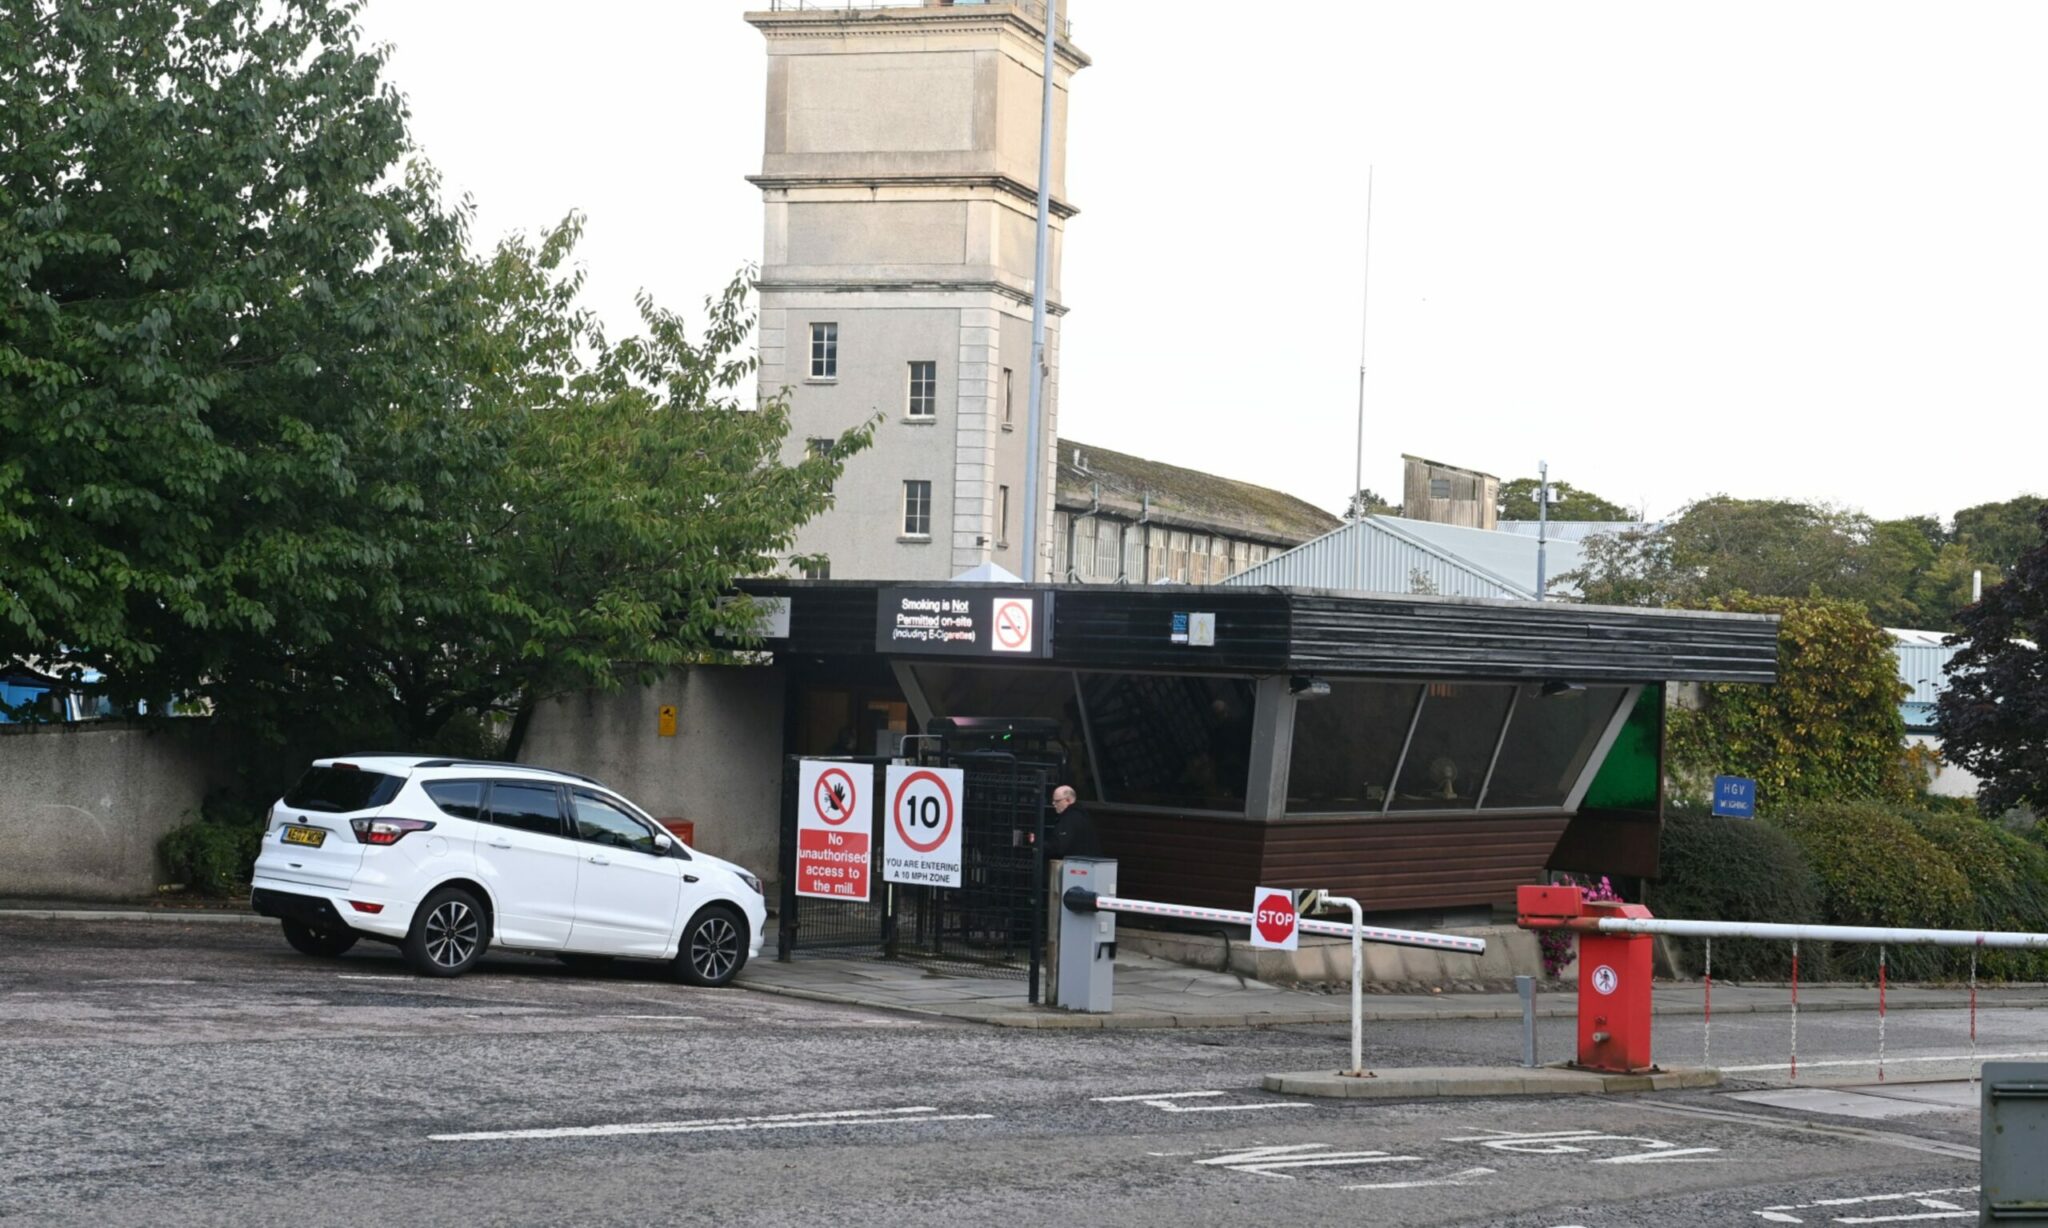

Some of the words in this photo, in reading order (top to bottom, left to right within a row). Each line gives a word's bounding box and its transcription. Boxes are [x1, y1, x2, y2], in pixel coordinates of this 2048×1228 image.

[901, 598, 940, 613] Smoking
[942, 599, 950, 611] is
[952, 599, 969, 612] Not
[896, 613, 939, 627] Permitted
[941, 616, 973, 627] on-site
[1723, 783, 1745, 795] HGV
[907, 795, 941, 829] 10
[828, 832, 843, 846] No
[799, 848, 868, 864] unauthorised
[806, 865, 844, 878] access
[848, 866, 860, 879] to
[886, 858, 902, 868] YOU
[903, 859, 919, 869] ARE
[921, 861, 959, 873] ENTERING
[901, 871, 910, 879] 10
[911, 871, 928, 881] MPH
[929, 872, 950, 883] ZONE
[813, 879, 830, 893] the
[834, 881, 856, 895] mill.
[1258, 910, 1294, 926] STOP
